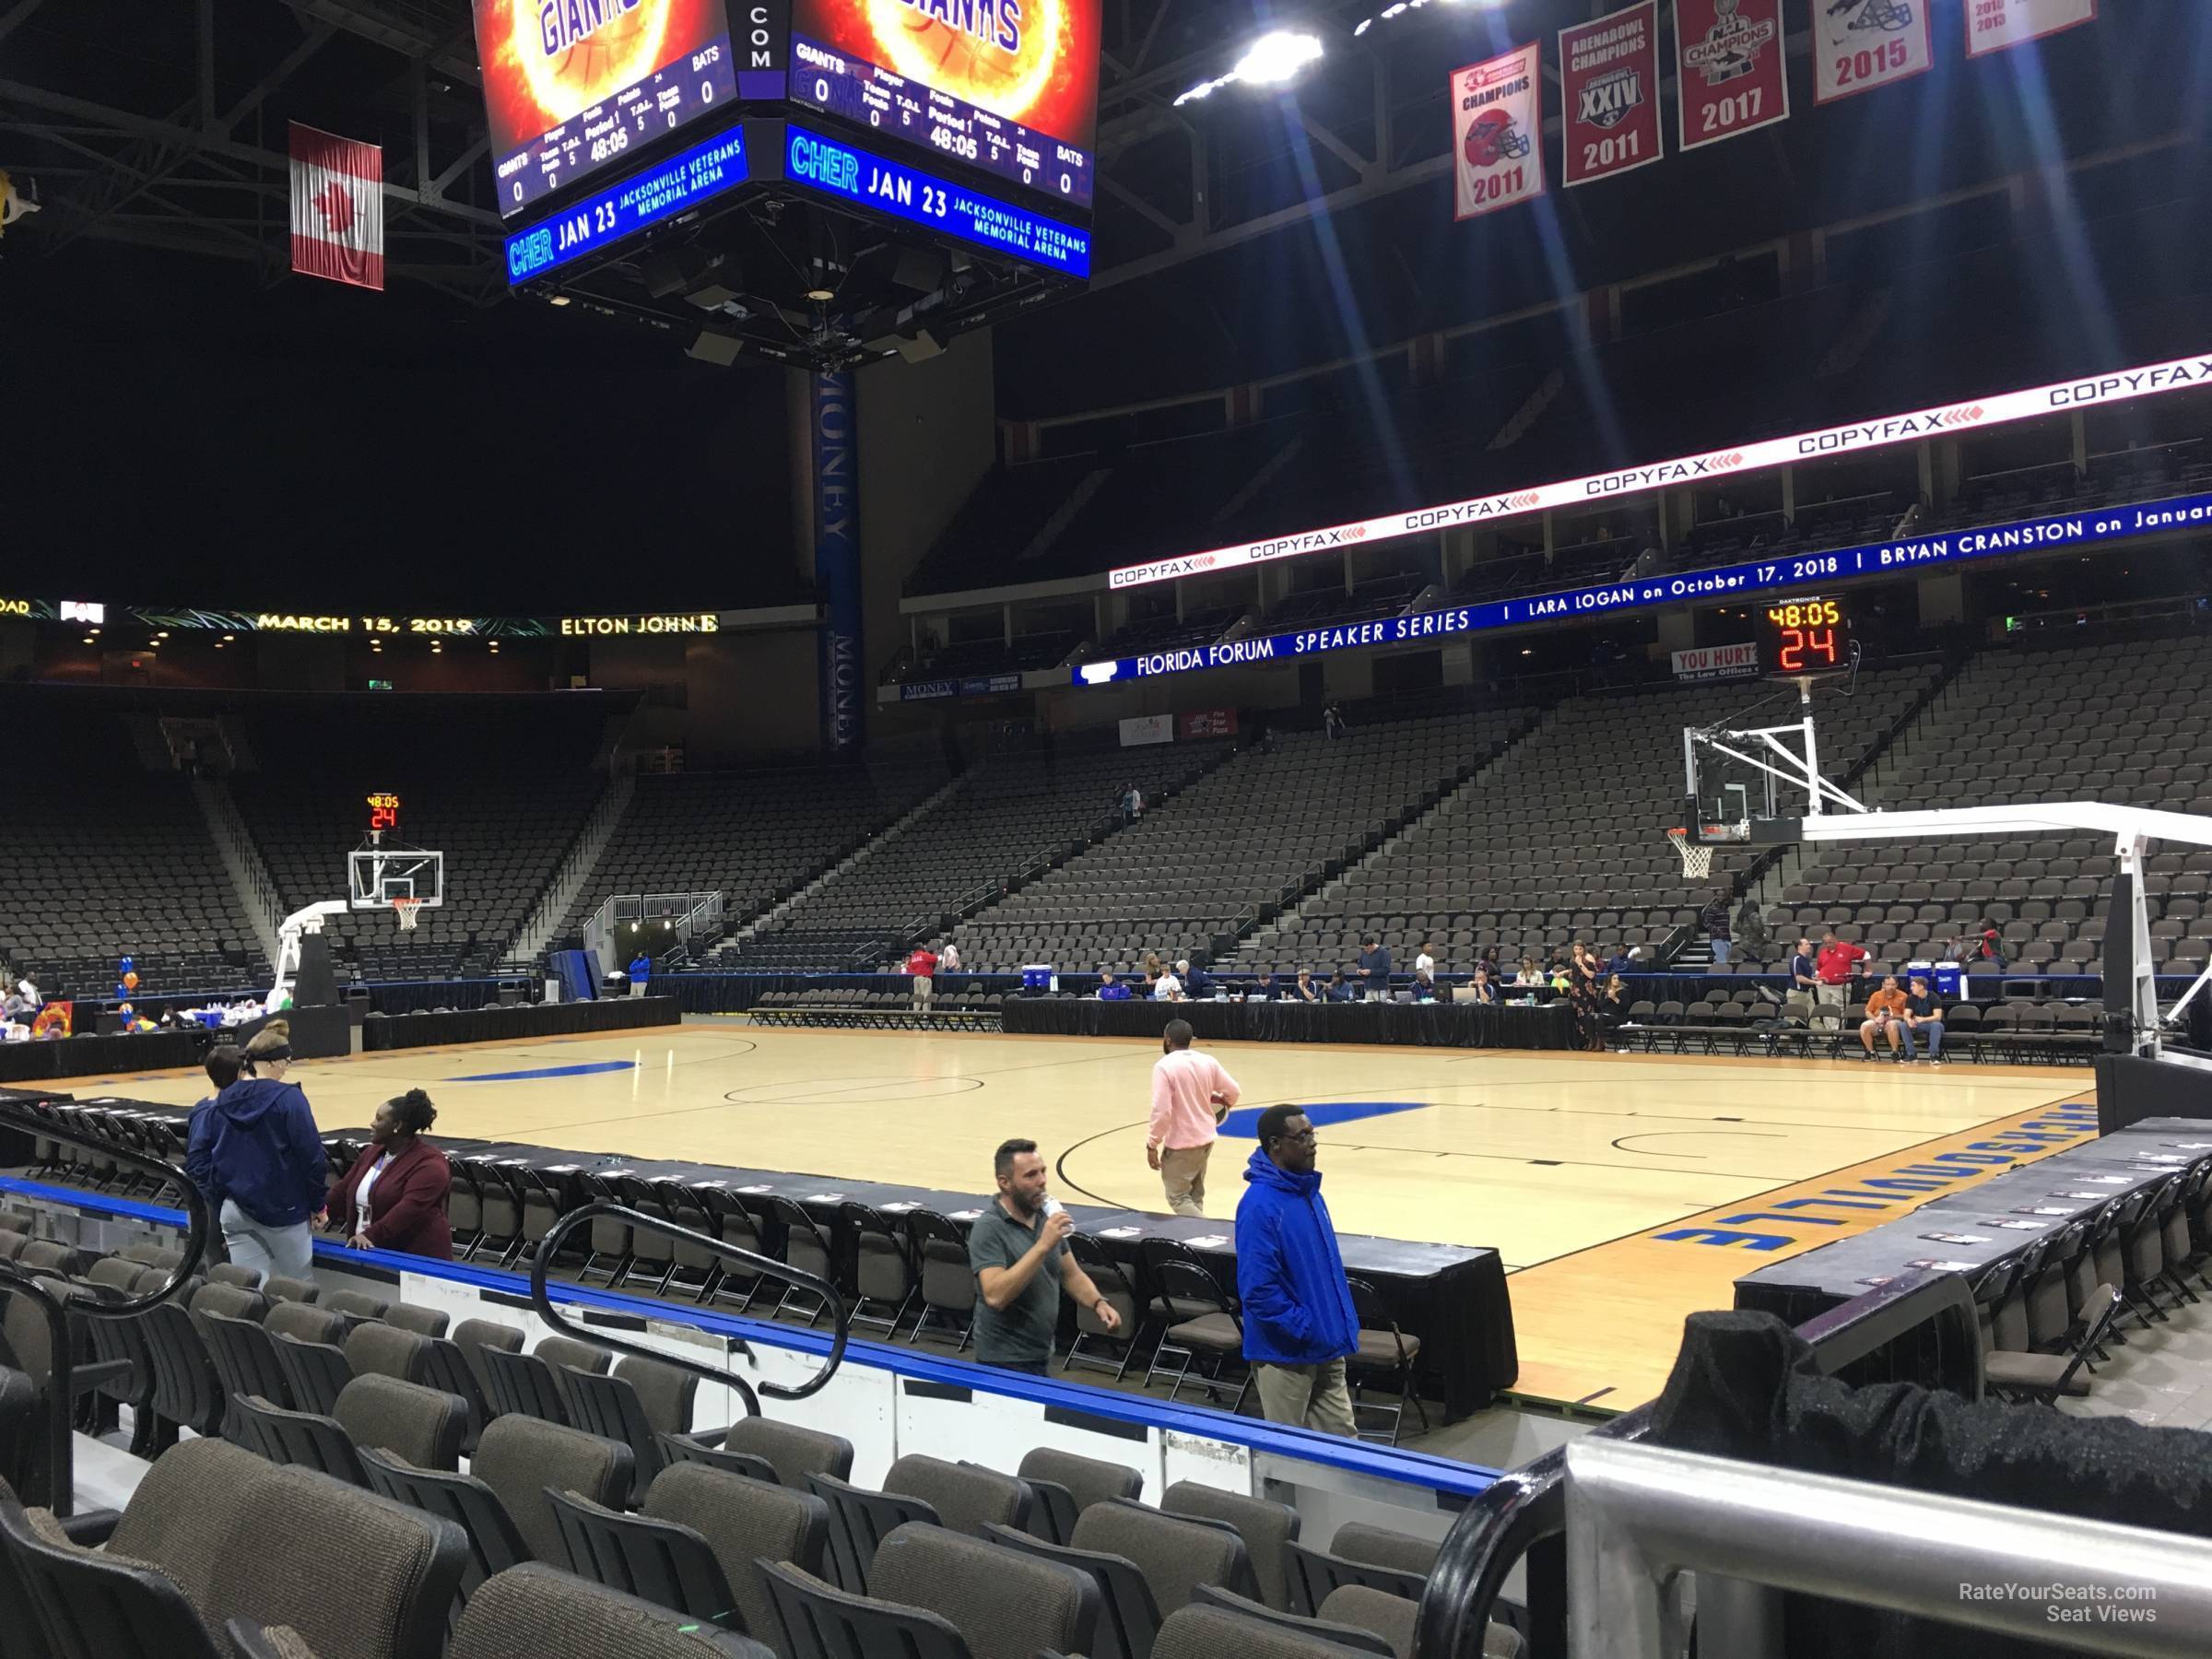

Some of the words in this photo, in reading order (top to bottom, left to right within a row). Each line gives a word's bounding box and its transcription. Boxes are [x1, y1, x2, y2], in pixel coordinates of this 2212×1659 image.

[541, 0, 641, 55] GIAN
[901, 0, 1019, 52] NTS
[1571, 18, 1644, 55] ARENABOWL
[1977, 13, 2006, 32] 2013
[1571, 35, 1646, 72] CHAMPIONS
[1689, 24, 1770, 61] CHAMPIONS
[692, 45, 720, 72] BATS
[796, 42, 845, 74] GIANTS
[1835, 38, 1908, 86] 2015
[701, 80, 712, 103] 0
[815, 79, 829, 101] 0
[863, 80, 891, 99] Team
[1463, 76, 1530, 112] CHAMPIONS
[1578, 75, 1639, 120] XXIV
[637, 116, 644, 131] 5
[667, 111, 676, 127] 0
[870, 110, 880, 126] 0
[902, 111, 911, 125] 5
[928, 106, 965, 131] Period
[967, 119, 972, 133] 1
[1701, 87, 1762, 132] 2017
[585, 116, 615, 140] Period
[615, 111, 620, 124] 1
[591, 126, 629, 162] 48:05
[930, 125, 978, 159] 48:05
[991, 147, 998, 160] 5
[1057, 145, 1083, 167] BATS
[1583, 129, 1639, 171] 2011
[498, 152, 528, 178] GIANTS
[569, 151, 576, 165] 5
[548, 173, 557, 188] 0
[619, 169, 687, 209] JACKSONVILLE
[688, 139, 741, 172] VETERANS
[792, 135, 858, 194] CHER
[868, 168, 912, 206] JAN
[923, 185, 947, 218] 23
[1023, 169, 1031, 184] 0
[1060, 173, 1071, 194] 0
[1474, 165, 1524, 204] 2011
[513, 182, 523, 202] 0
[638, 187, 688, 217] MEMORIAL
[690, 168, 724, 192] ARENA
[509, 229, 555, 276] CHER
[559, 207, 590, 251] JAN
[595, 201, 617, 233] 23
[954, 196, 1031, 234] JACKSONVILLE
[1035, 226, 1086, 253] VETERANS
[973, 219, 1030, 250] MEMORIAL
[1033, 238, 1067, 261] ARENA
[2050, 360, 2212, 406] COPYFAX
[1798, 413, 1944, 453] COPYFAX
[1586, 458, 1710, 495] COPYFAX
[1406, 497, 1512, 529] COPYFAX
[1250, 531, 1342, 559] COPYFAX
[1113, 559, 1194, 585] COPYFAX
[1136, 649, 1203, 677] FLORIDA
[1209, 638, 1274, 665] FORUM
[1294, 623, 1383, 653] SPEAKER
[1395, 610, 1468, 638] SERIES
[1529, 598, 1567, 617] LARA
[1575, 587, 1634, 609] LOGAN
[1643, 586, 1663, 599] on
[1671, 572, 1745, 595] October
[1757, 567, 1783, 583] 17,
[1794, 557, 1838, 578] 2018
[1880, 539, 1947, 565] BRYAN
[1959, 520, 2083, 553] CRANSTON
[2096, 517, 2121, 534] on
[257, 615, 349, 631] MARCH
[363, 618, 400, 634] 15,
[411, 618, 473, 632] 2019
[561, 618, 629, 635] ELTON
[637, 617, 696, 634] JOHN
[1769, 601, 1840, 628] 48:05
[1679, 651, 1708, 670] YOU
[1781, 629, 1836, 669] 24
[1697, 670, 1716, 678] Law
[1719, 665, 1752, 676] Offices
[904, 681, 953, 695] MONEY
[368, 796, 399, 807] 48:05
[372, 808, 394, 828] 24
[1651, 1103, 2100, 1252] JACKSONVILLE
